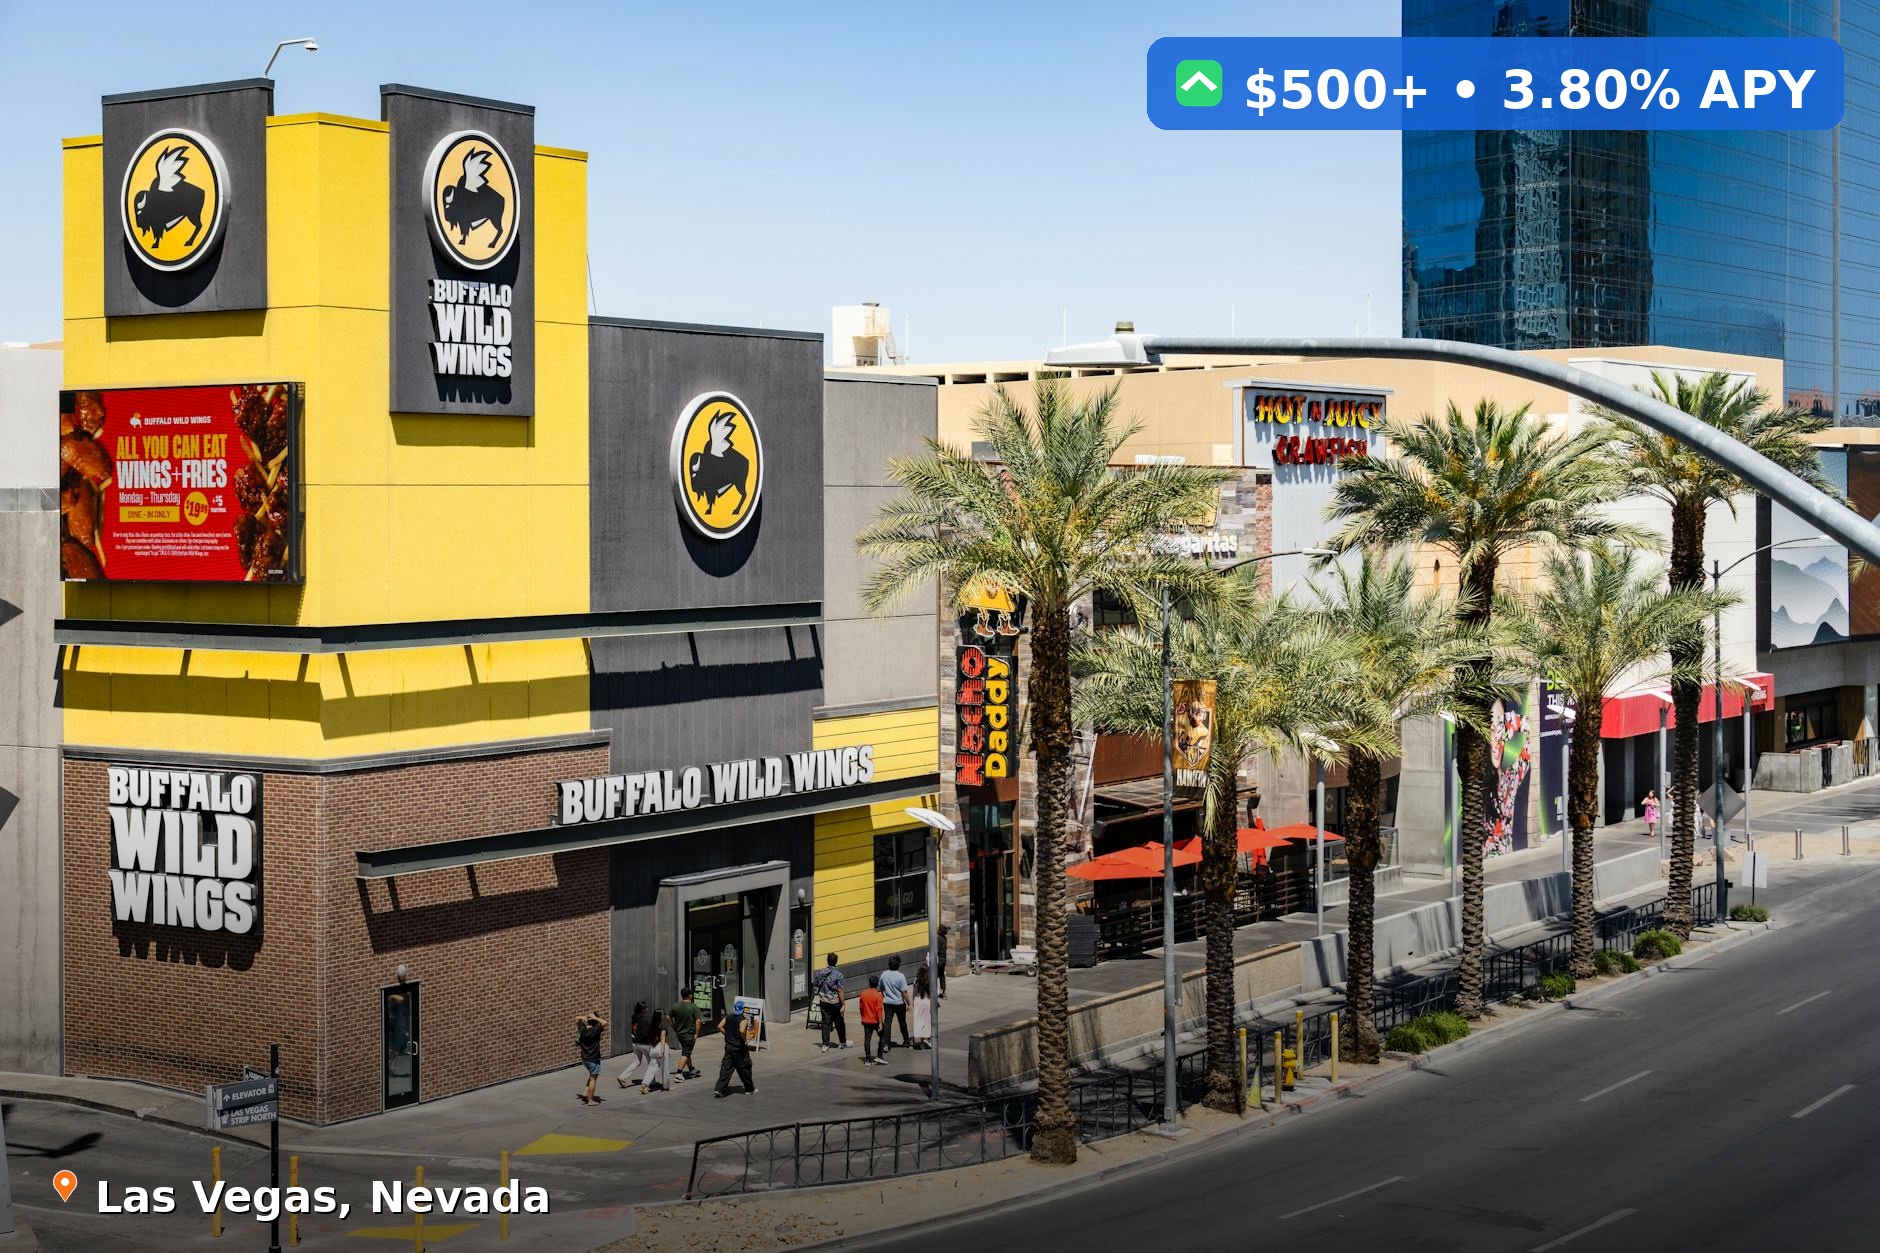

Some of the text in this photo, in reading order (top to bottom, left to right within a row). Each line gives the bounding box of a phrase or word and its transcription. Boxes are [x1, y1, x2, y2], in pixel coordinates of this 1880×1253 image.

[433, 279, 512, 308] BUFFALO
[433, 303, 512, 346] WILD
[433, 342, 512, 378] WINGS
[144, 415, 212, 426] BUFFALO WILD WINGS
[1255, 395, 1382, 428] HOT N JUICY
[116, 433, 228, 460] ALL YOU CAN EAT
[118, 491, 144, 506] Monday
[150, 491, 181, 506] Thursday
[127, 510, 142, 519] DINE
[154, 510, 171, 518] ONLY
[955, 645, 985, 786] Nacho
[985, 656, 1010, 778] Daddy
[107, 767, 255, 814] BUFFALO
[557, 744, 875, 826] BUFFALO WILD WINGS
[107, 806, 256, 880] WILD
[107, 869, 256, 935] WINGS
[231, 1087, 267, 1101] ELEVATOR
[230, 1104, 269, 1118] LAS VEGAS
[230, 1111, 277, 1126] STRIP NORTH
